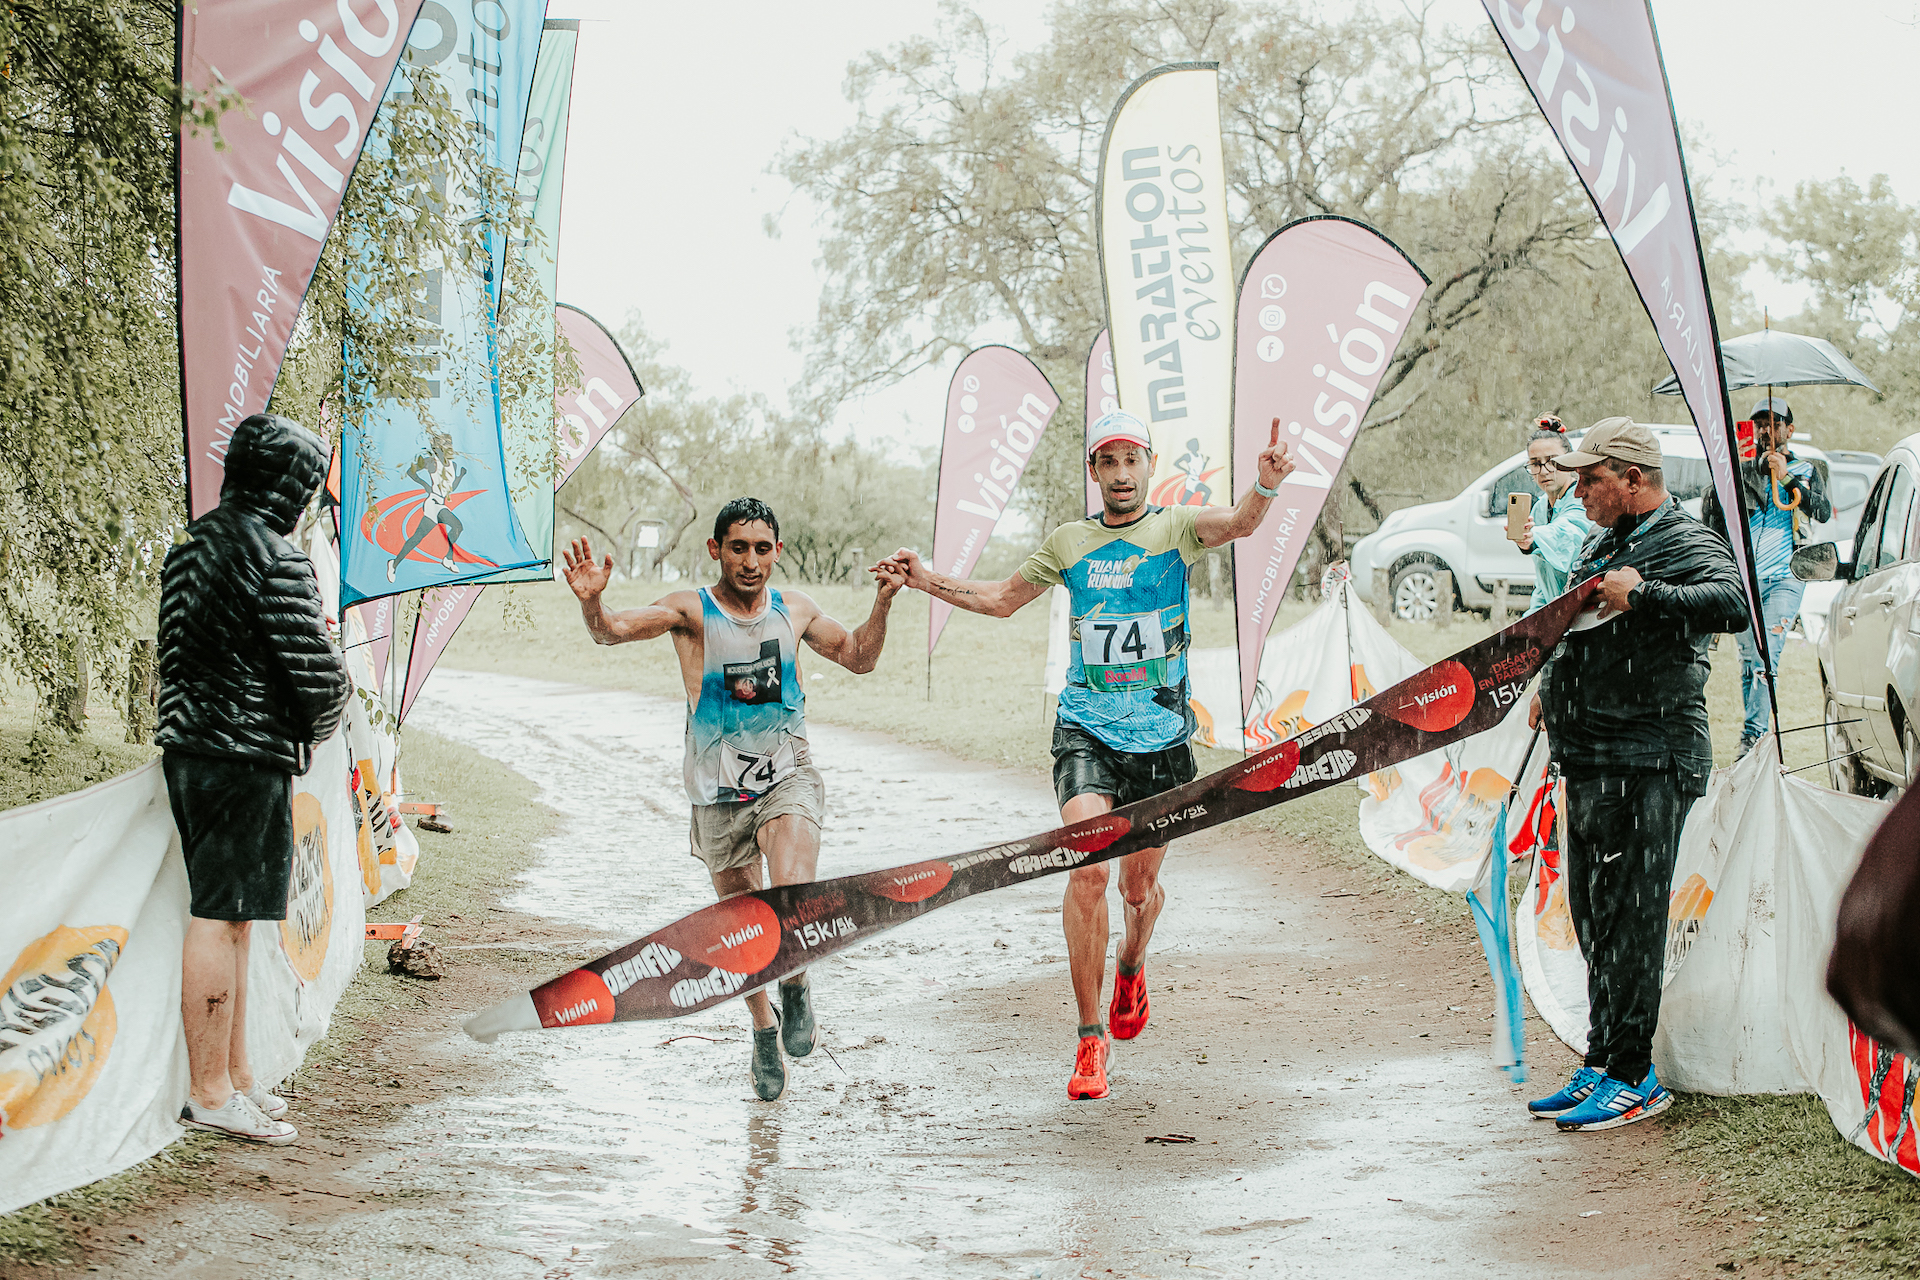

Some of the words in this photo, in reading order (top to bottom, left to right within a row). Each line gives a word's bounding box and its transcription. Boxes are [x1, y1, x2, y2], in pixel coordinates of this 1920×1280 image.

[1166, 144, 1222, 342] eventos
[1122, 146, 1188, 422] MARATHON
[206, 265, 282, 468] INMOBILIARIA
[1286, 280, 1411, 491] Visión
[956, 393, 1050, 522] Visión
[1087, 572, 1134, 589] RUNNING
[1088, 559, 1123, 574] PUAN
[1251, 506, 1300, 626] INMOBILIARIA
[1094, 621, 1147, 663] 74
[1414, 682, 1457, 708] Visión
[737, 753, 776, 788] 74
[721, 922, 764, 950] Visión
[555, 996, 599, 1025] Visión
